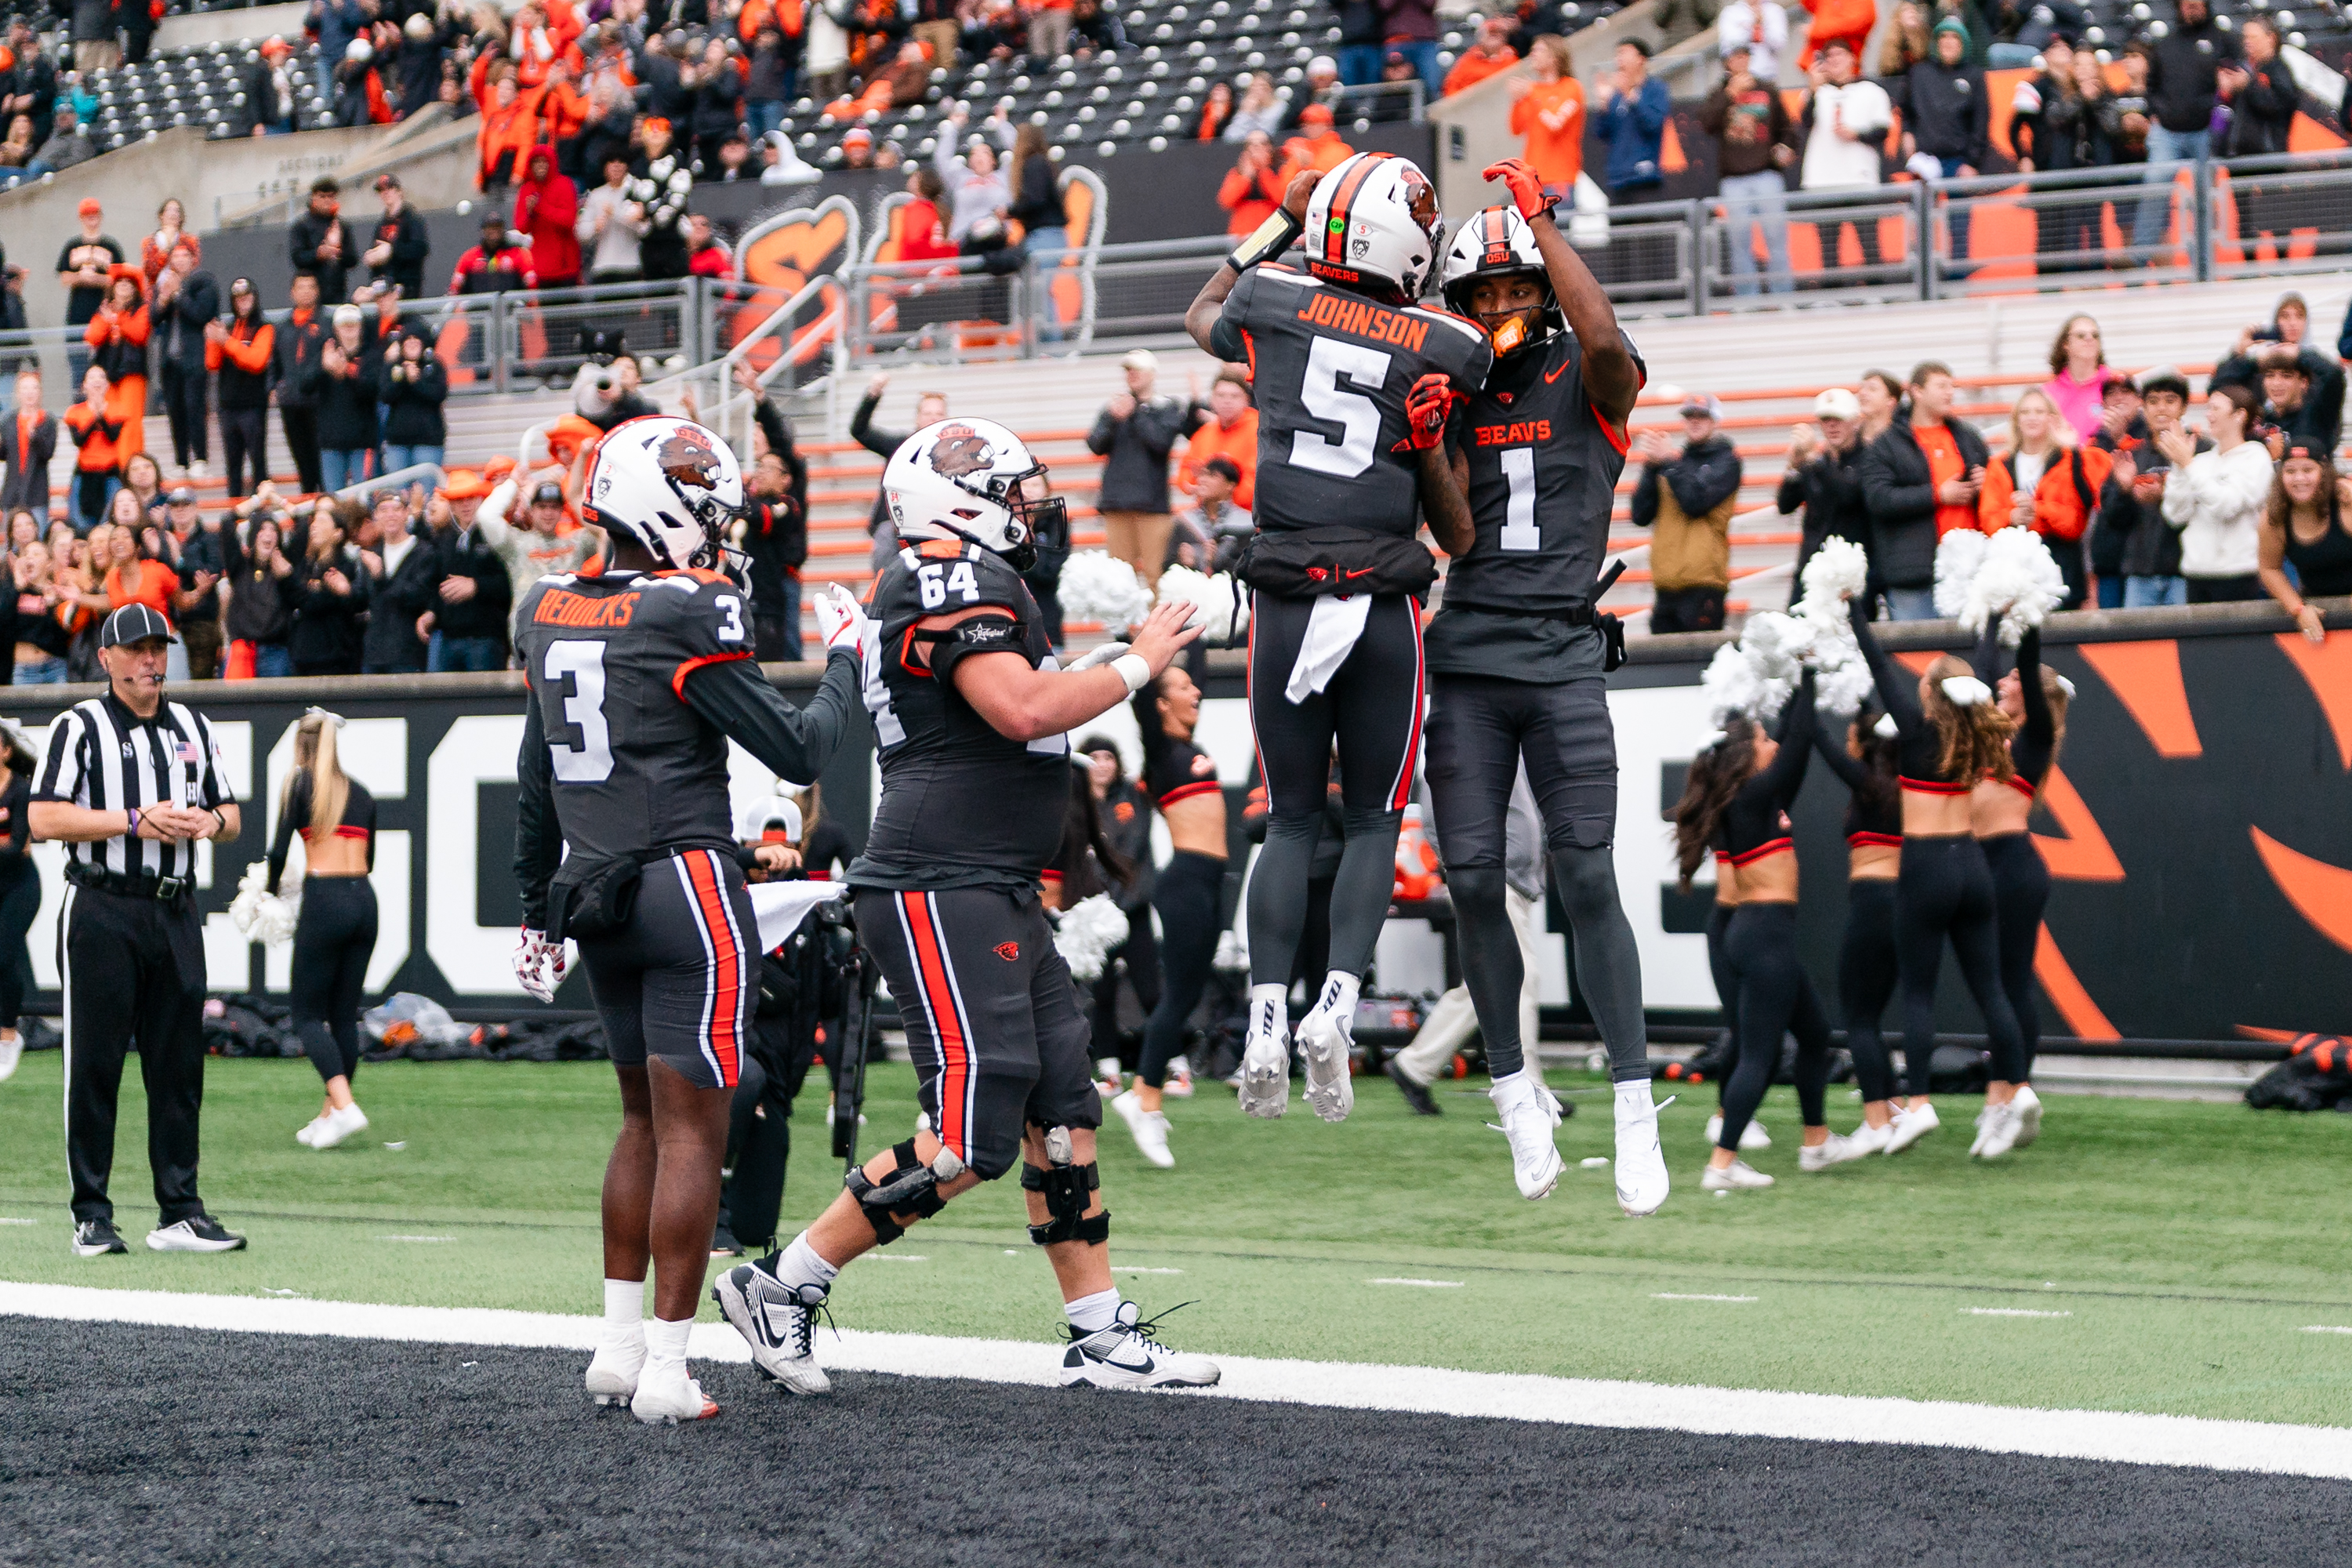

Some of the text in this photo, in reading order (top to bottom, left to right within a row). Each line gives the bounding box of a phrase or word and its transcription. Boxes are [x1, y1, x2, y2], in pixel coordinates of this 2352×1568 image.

[1330, 220, 1343, 229] C2P
[1360, 225, 1367, 234] 5
[1311, 262, 1359, 282] BEAVERS
[1486, 252, 1510, 263] OSU
[1297, 293, 1430, 353] JOHNSON
[1287, 335, 1392, 478] 5
[1475, 419, 1552, 446] BEAVS
[1500, 447, 1541, 550] 1
[917, 561, 980, 609] 64
[533, 588, 641, 627] REDDICKS
[715, 594, 745, 641] 3
[544, 640, 615, 782] 3
[187, 781, 197, 803] H
